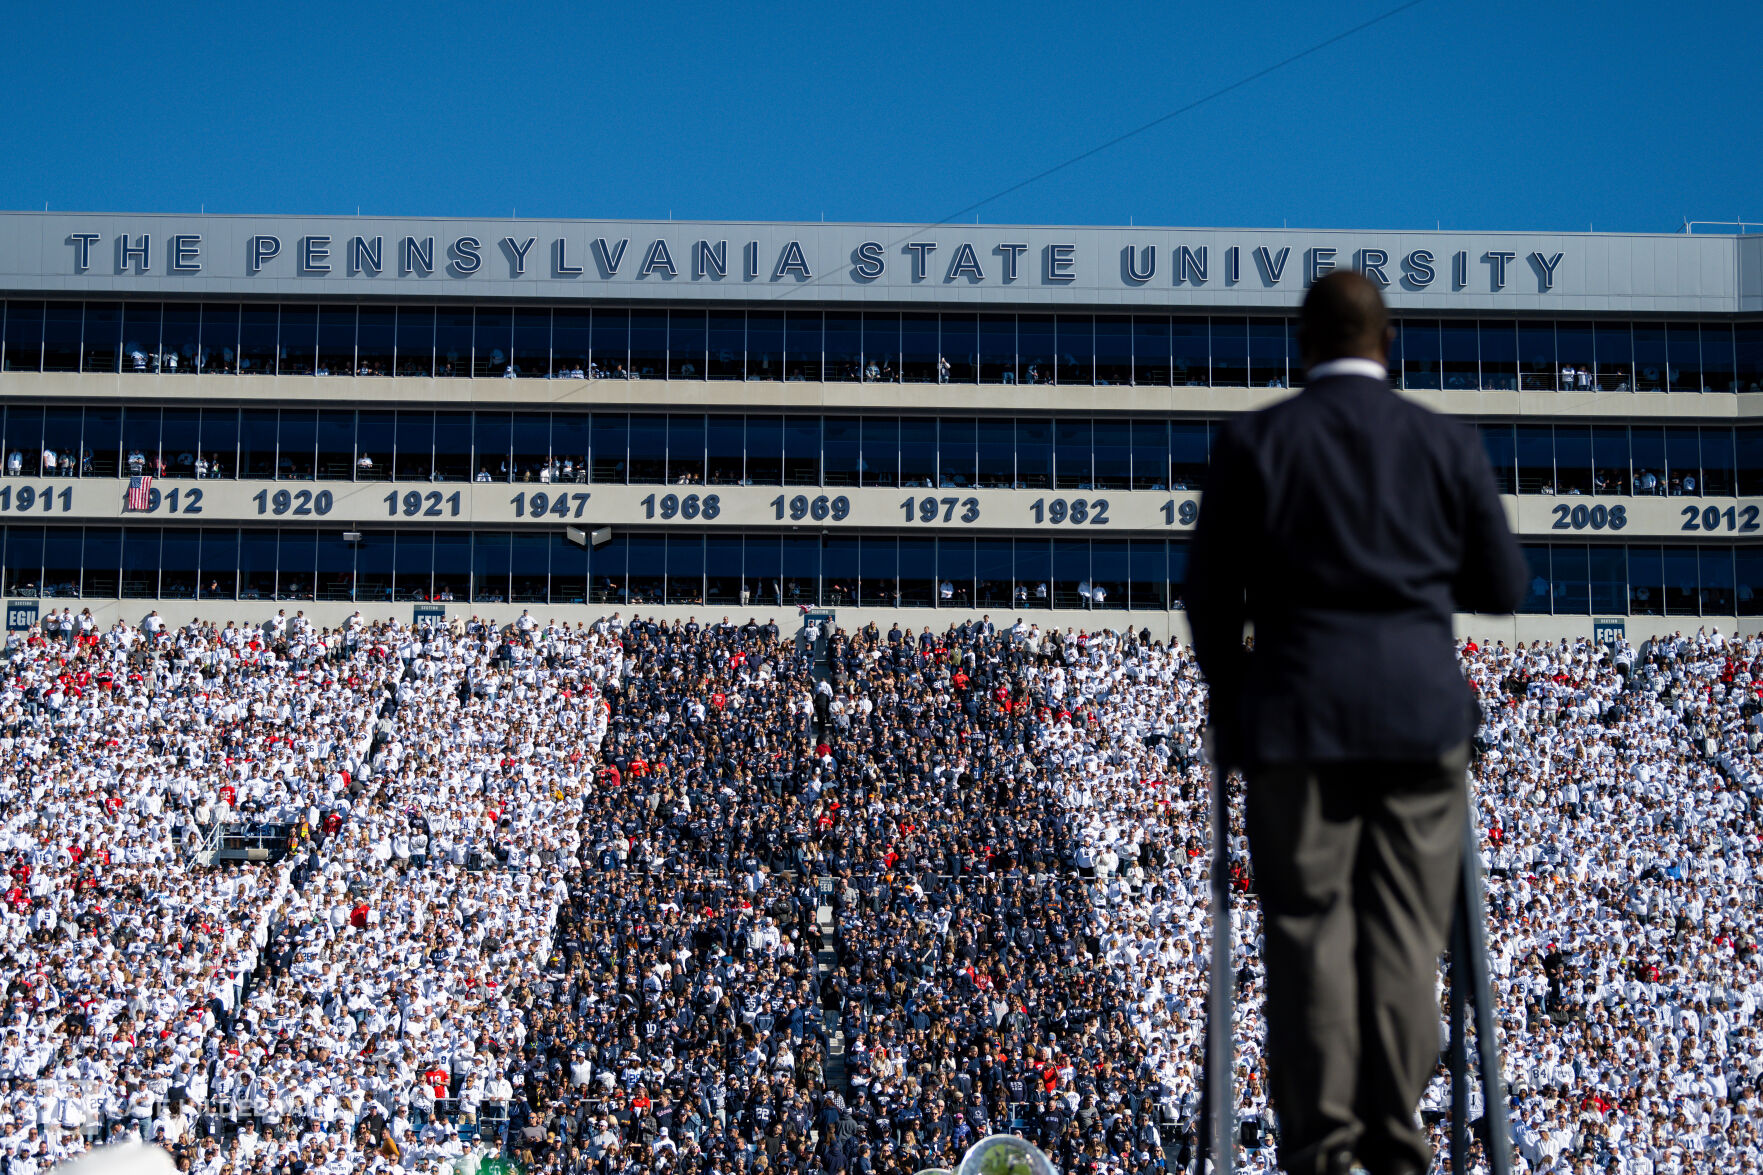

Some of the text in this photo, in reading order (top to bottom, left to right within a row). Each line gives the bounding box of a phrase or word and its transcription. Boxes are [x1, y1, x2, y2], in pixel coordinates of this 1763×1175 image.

[70, 232, 1565, 288] THE PENNSYLVANIA STATE UNIVERSITY
[0, 485, 72, 512] 1911
[122, 487, 203, 514] 912
[252, 489, 334, 516] 1920
[383, 490, 461, 517] 1921
[510, 491, 591, 518] 1947
[641, 493, 721, 520] 1968
[770, 494, 850, 521] 1969
[899, 496, 981, 523] 1973
[1029, 498, 1110, 525] 1982
[1160, 500, 1197, 525] 19
[1551, 503, 1627, 530] 2008
[1680, 505, 1760, 532] 2012
[9, 610, 36, 626] EGU
[604, 856, 610, 865] 6
[1533, 1068, 1547, 1079] 84
